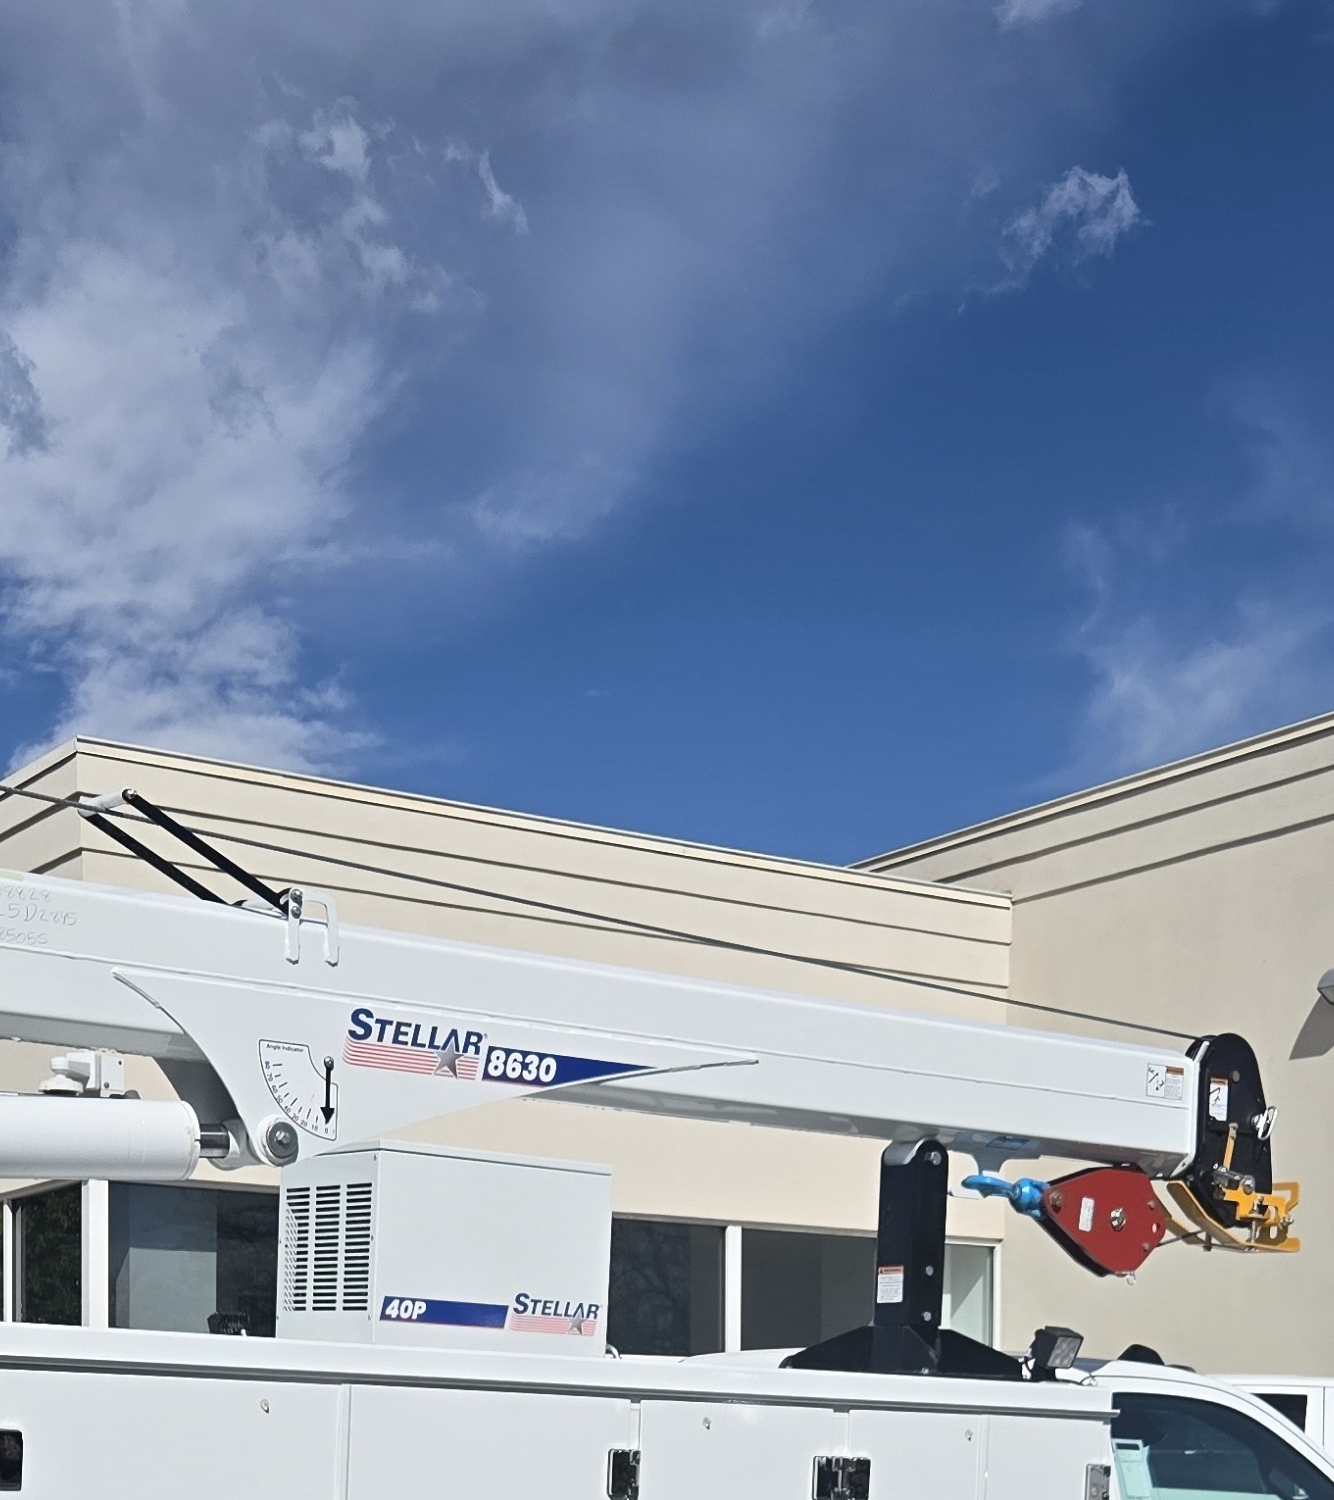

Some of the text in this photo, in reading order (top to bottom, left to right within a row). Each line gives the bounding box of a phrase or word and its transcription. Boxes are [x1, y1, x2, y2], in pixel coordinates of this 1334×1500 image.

[347, 1007, 557, 1082] STELLAR 8630
[385, 1292, 600, 1320] 40P STELLAR
